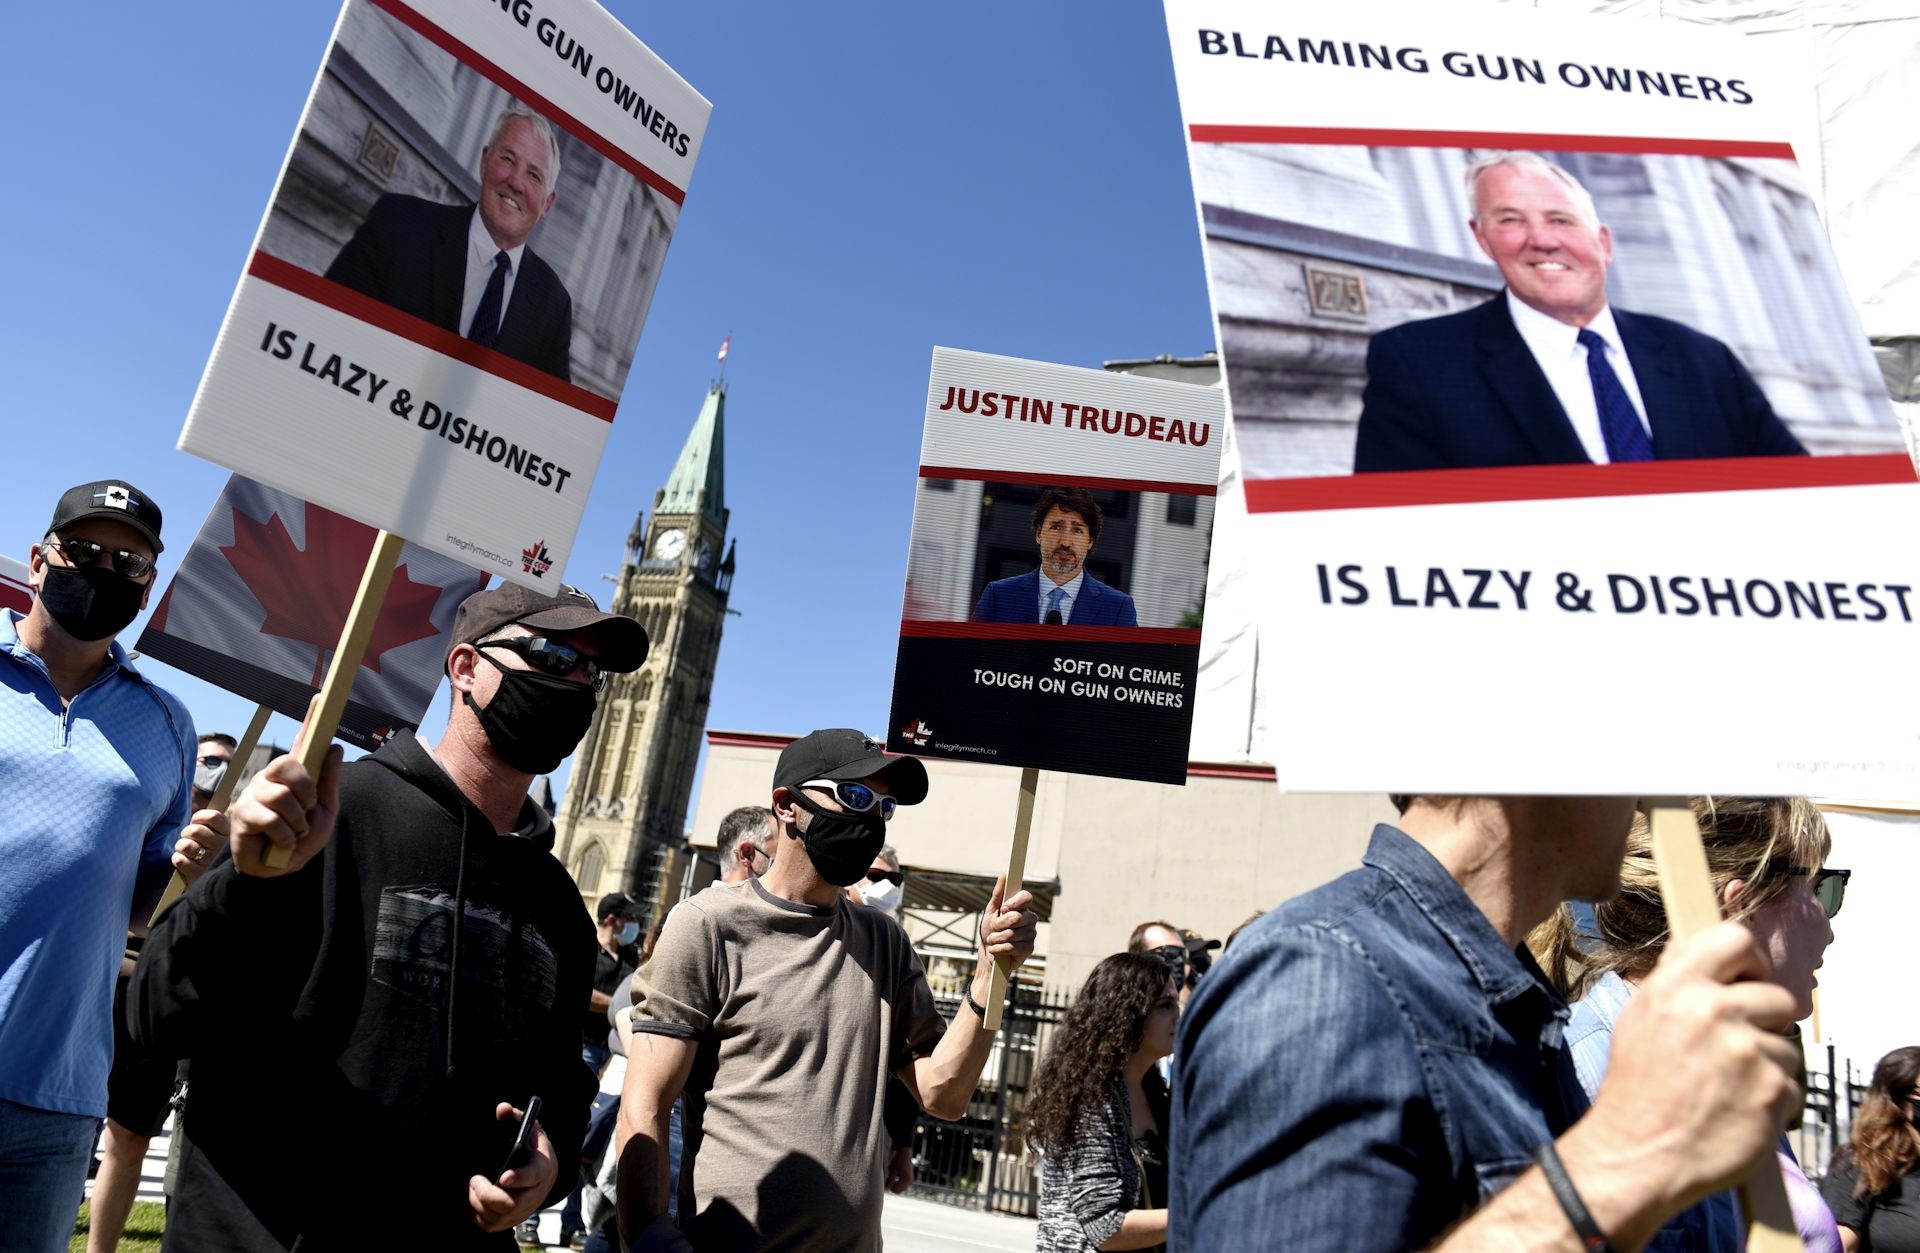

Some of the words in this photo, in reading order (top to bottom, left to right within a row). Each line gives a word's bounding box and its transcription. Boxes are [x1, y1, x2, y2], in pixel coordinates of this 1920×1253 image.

[1198, 28, 1430, 73] BLAMING
[1442, 51, 1546, 84] GUN
[1558, 62, 1753, 104] OWNERS
[536, 18, 593, 78] GUN
[595, 66, 691, 158] OWNERS
[1314, 273, 1360, 311] 275
[259, 322, 297, 360] IS
[299, 342, 389, 403] LAZY
[389, 388, 414, 421] &
[417, 400, 571, 493] DISHONEST
[939, 386, 1054, 425] JUSTIN
[1061, 402, 1210, 447] TRUDEAU
[446, 532, 513, 568] integritymarch.ca
[521, 556, 534, 565] THE
[1316, 564, 1369, 605] IS
[1385, 566, 1532, 610] LAZY
[1555, 571, 1597, 613] &
[1607, 574, 1912, 623] DISHONEST
[974, 669, 1034, 690] TOUGH
[1038, 677, 1066, 694] ON
[1071, 681, 1109, 699] GUN
[1114, 686, 1183, 708] OWNERS
[1053, 657, 1094, 676] SOFT
[1097, 663, 1124, 680] ON
[1129, 667, 1185, 689] CRIME,
[902, 731, 915, 739] THE
[934, 741, 998, 755] integritymarch.ca
